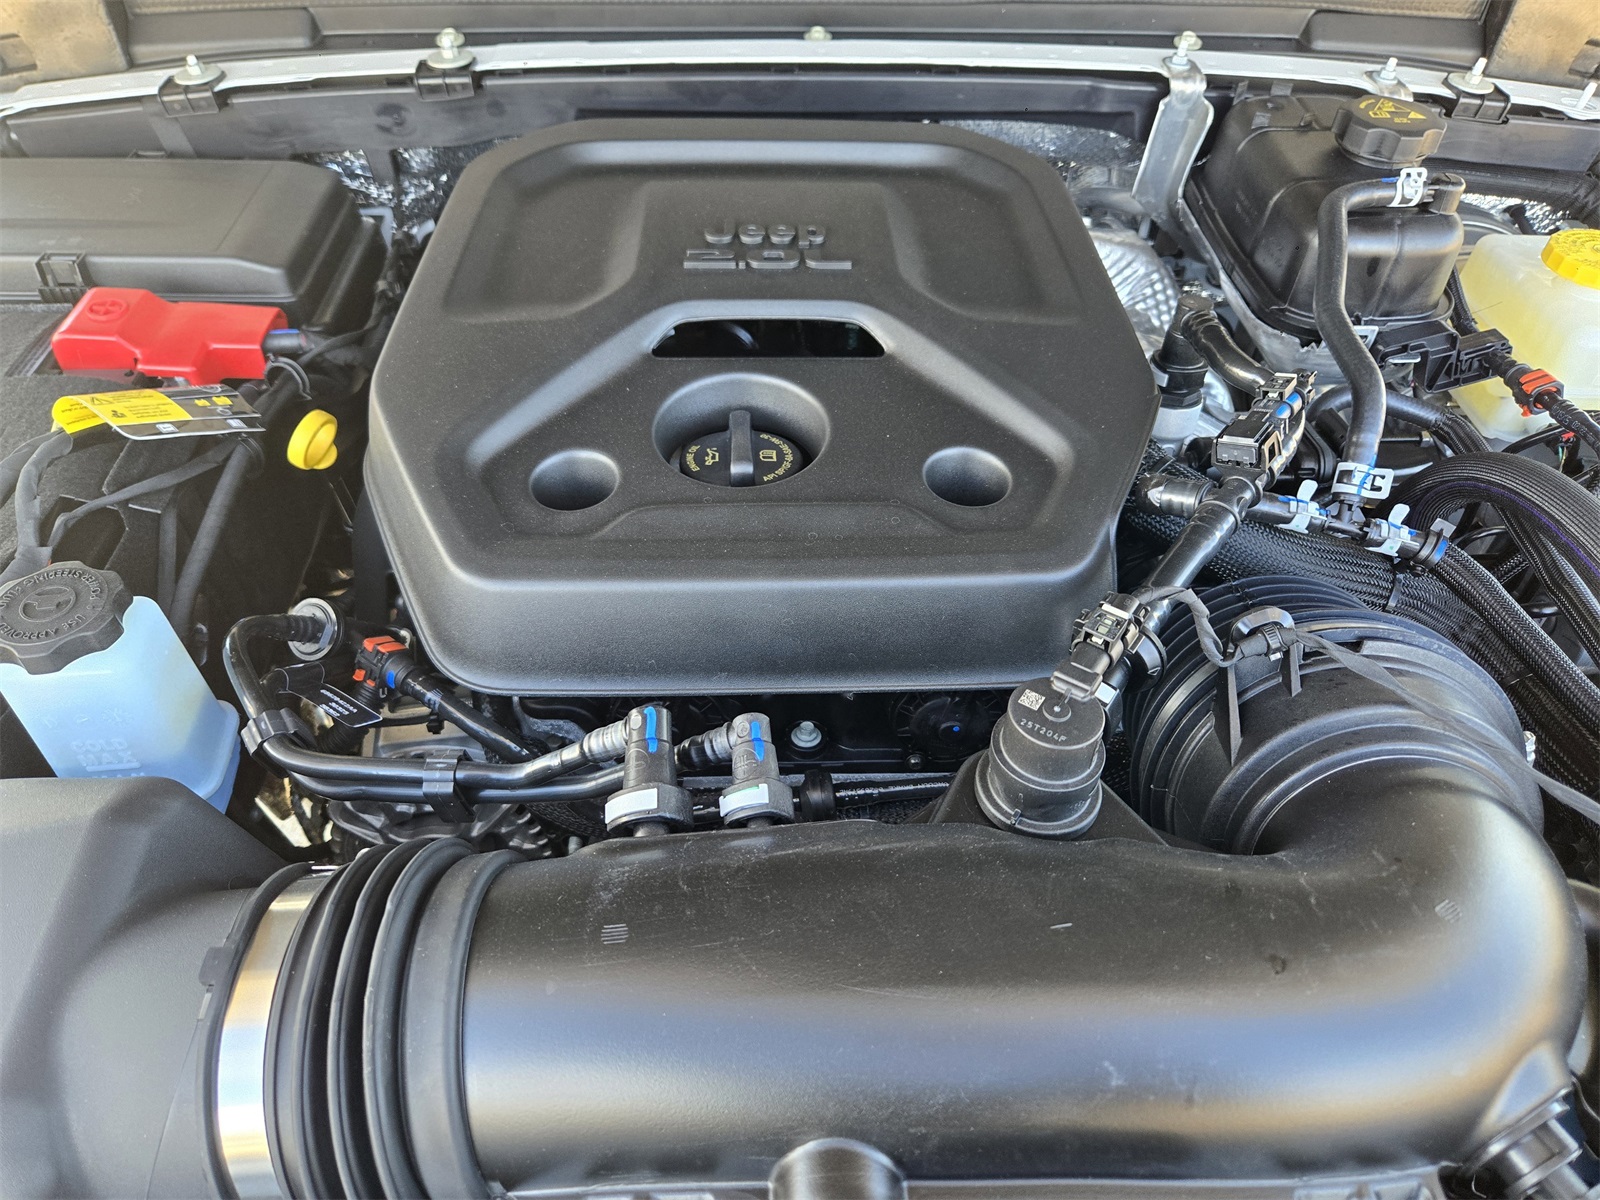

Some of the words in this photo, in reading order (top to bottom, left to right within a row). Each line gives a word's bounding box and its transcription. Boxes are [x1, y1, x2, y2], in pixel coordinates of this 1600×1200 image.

[703, 219, 826, 248] Jeep
[683, 250, 852, 270] 2.0L
[763, 473, 778, 481] API
[23, 569, 82, 586] STEERING
[81, 573, 101, 600] POWER
[62, 613, 85, 631] USE
[70, 739, 127, 752] COLD
[76, 751, 138, 767] MAX
